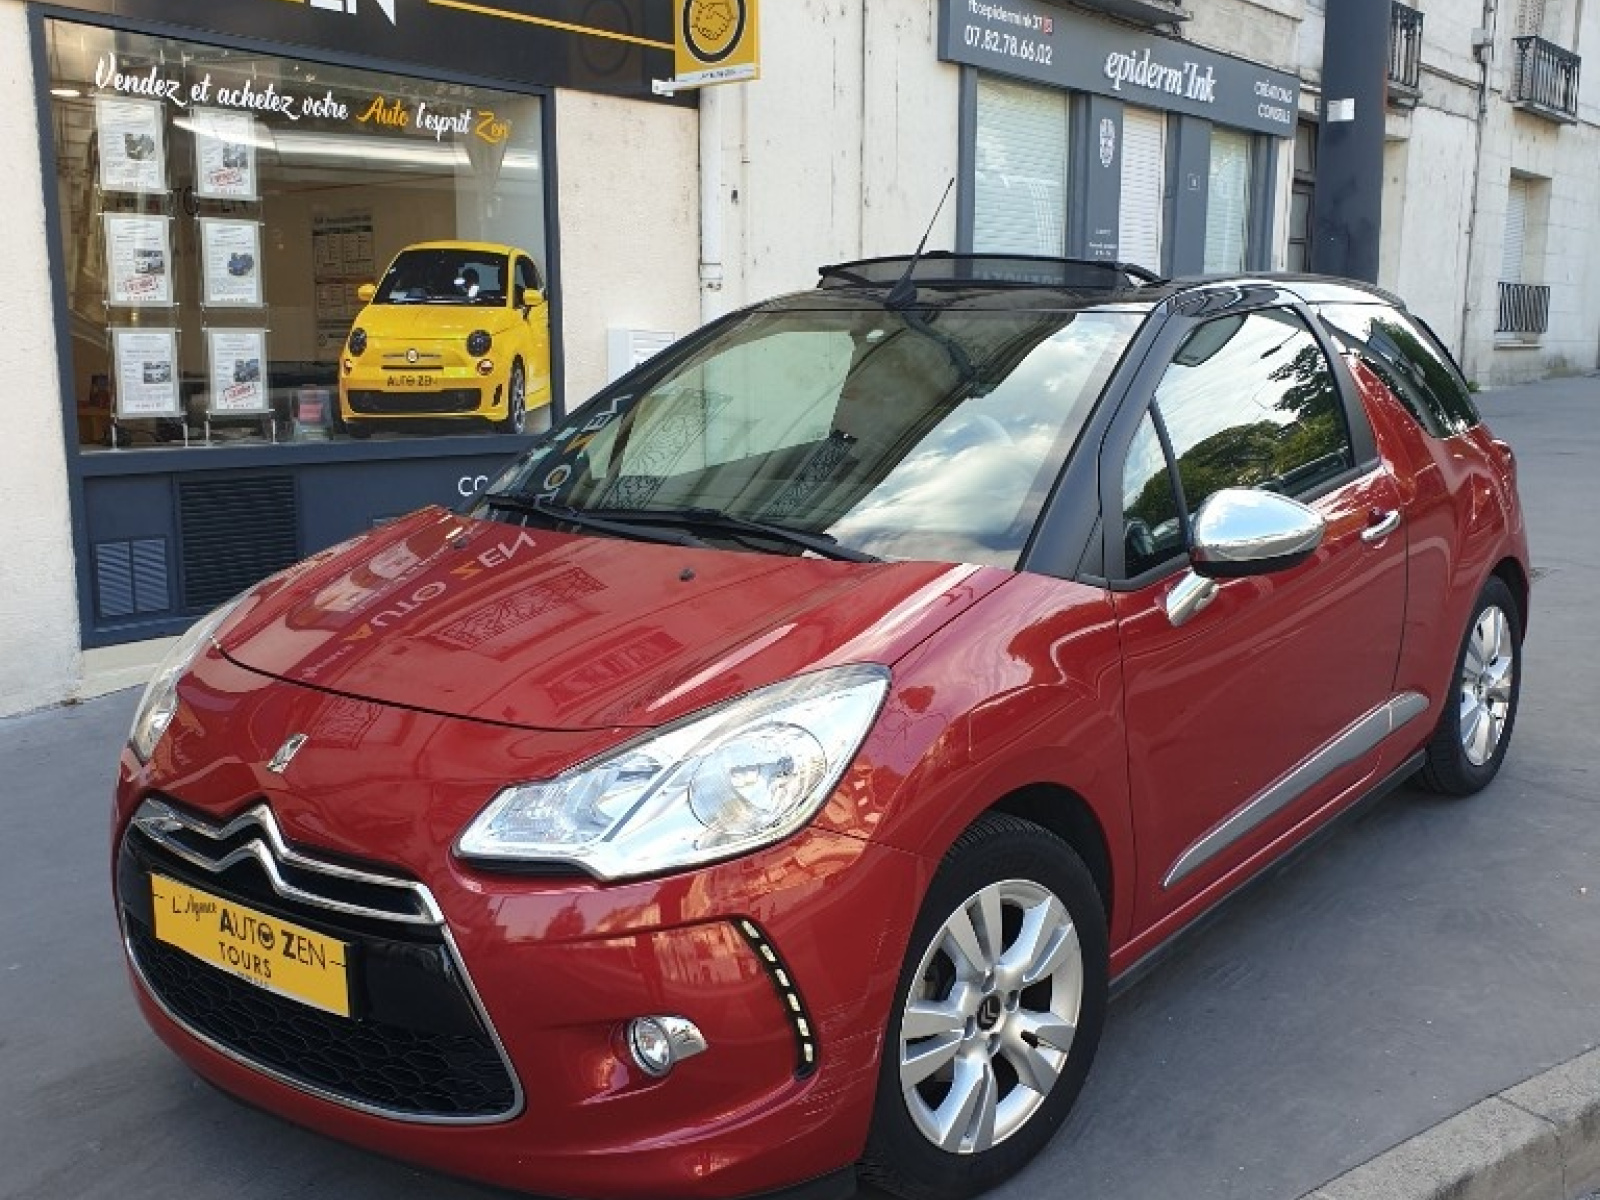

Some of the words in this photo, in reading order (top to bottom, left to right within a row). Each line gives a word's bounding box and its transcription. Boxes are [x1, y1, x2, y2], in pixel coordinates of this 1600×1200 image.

[964, 25, 1053, 66] 07.82.78.66.02
[95, 51, 188, 107] Vendez
[191, 73, 212, 101] et
[216, 80, 300, 120] achetez
[302, 90, 349, 121] votre
[356, 96, 410, 128] Auto
[474, 110, 510, 144] Zen
[218, 941, 272, 979] TOURS
[219, 908, 275, 951] AUTO
[281, 929, 327, 970] ZEN
